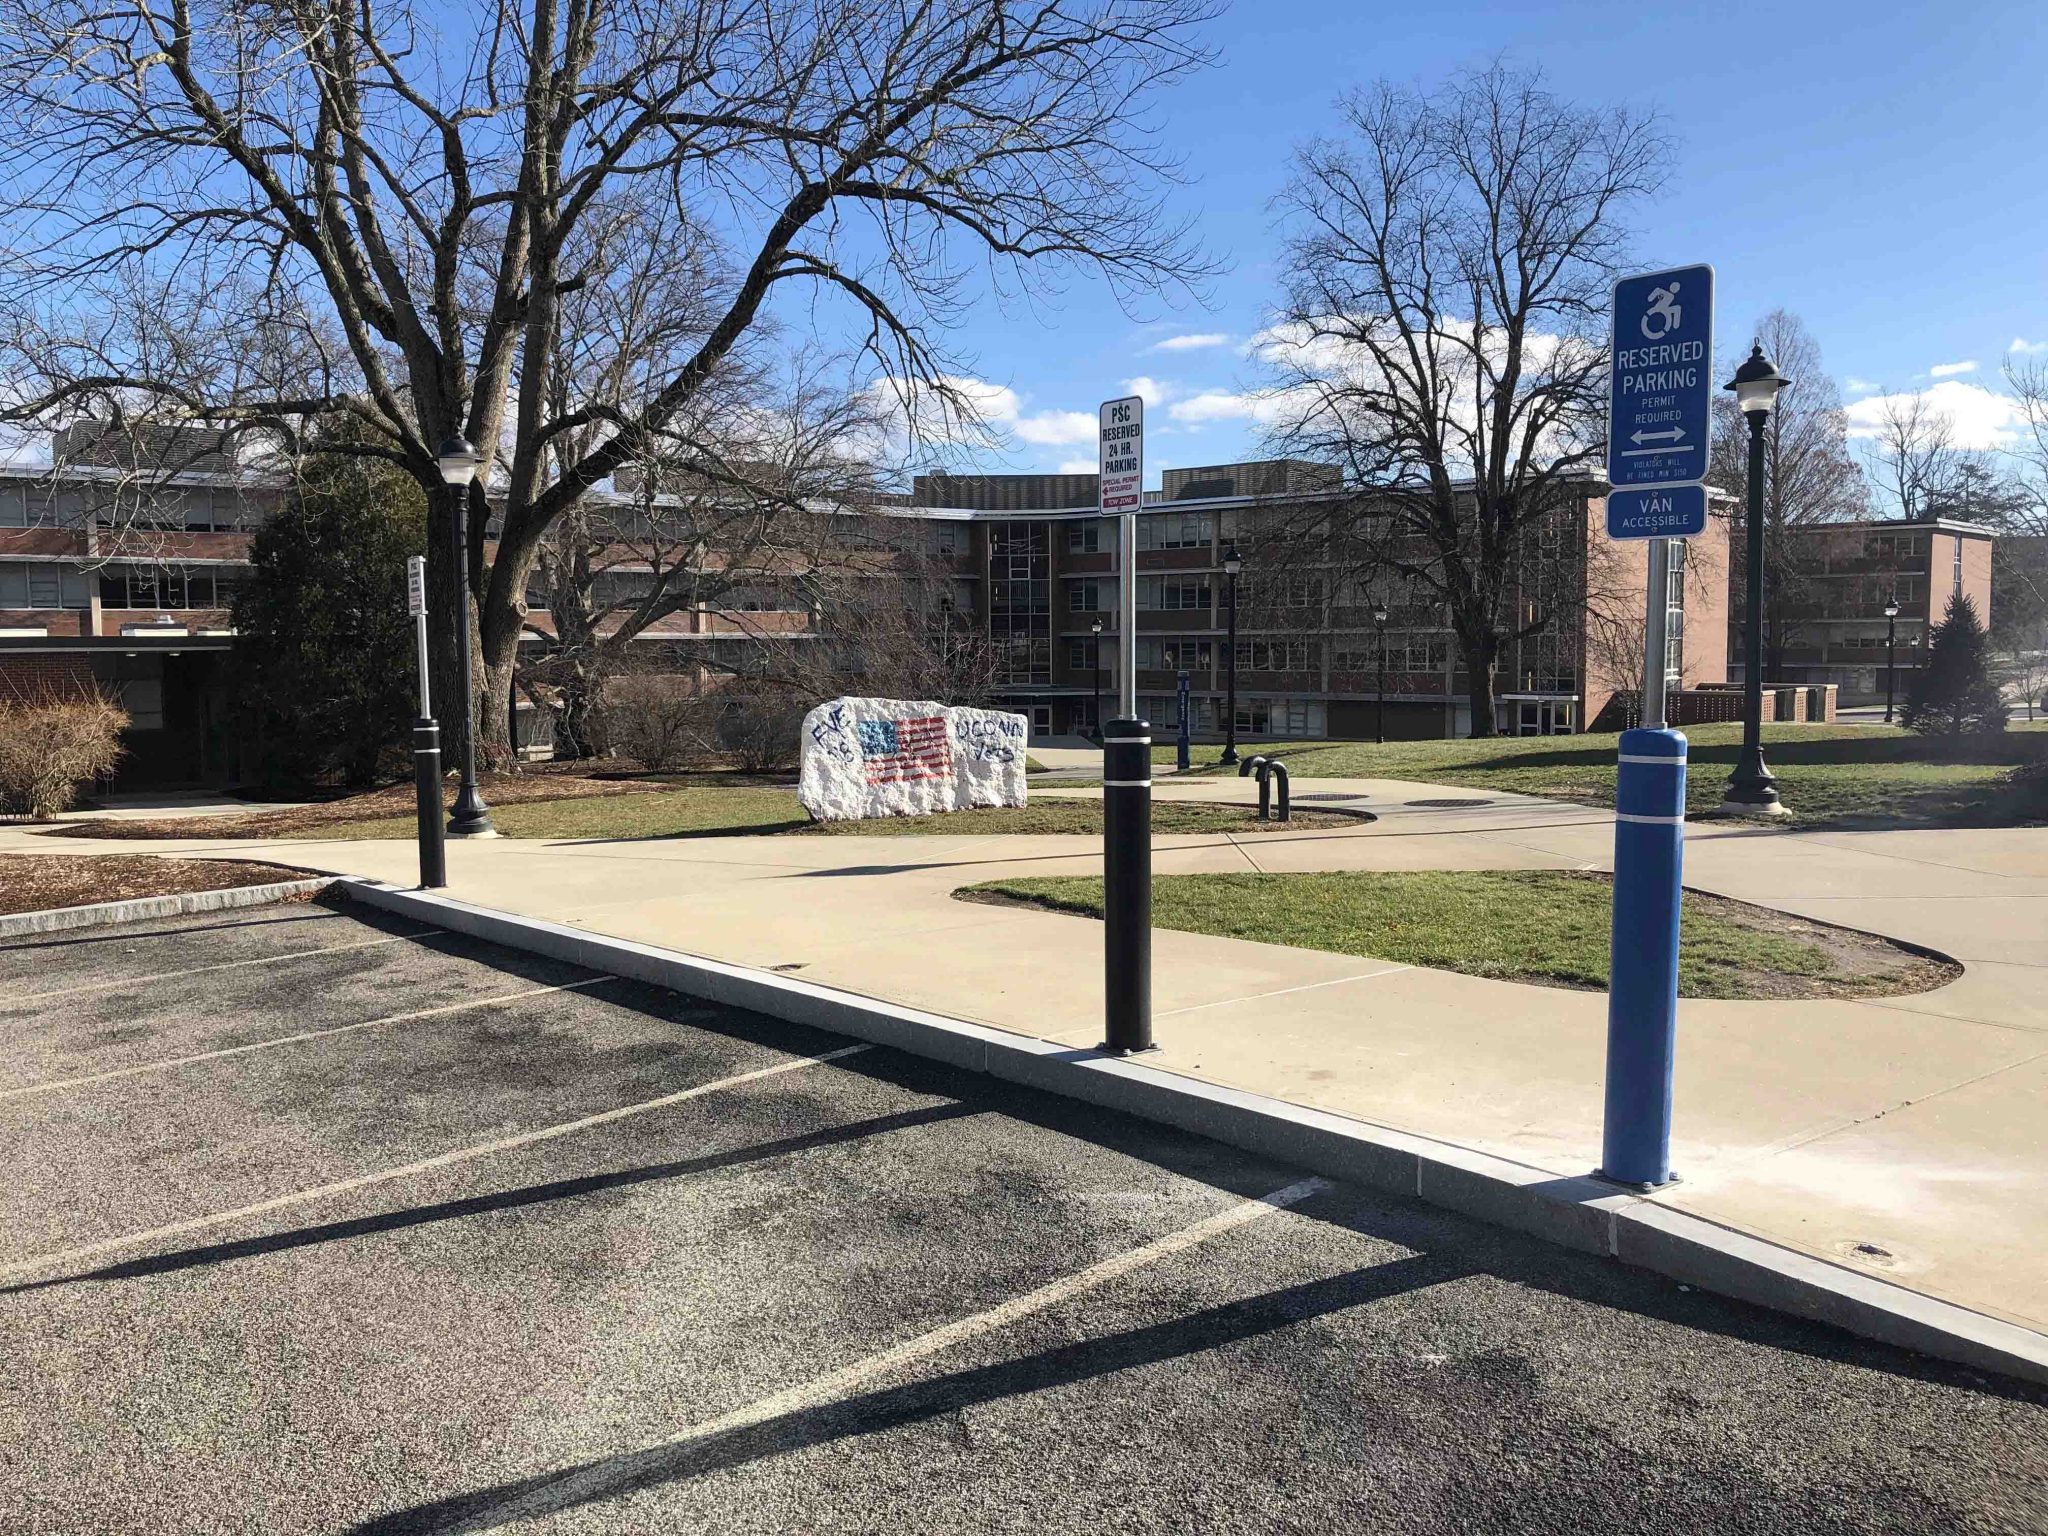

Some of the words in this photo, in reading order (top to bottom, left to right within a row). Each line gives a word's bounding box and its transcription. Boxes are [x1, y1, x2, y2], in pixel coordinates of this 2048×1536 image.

[1618, 341, 1703, 370] RESERVED
[1623, 367, 1697, 395] PARKING
[1642, 395, 1676, 409] PERMIT
[1112, 405, 1130, 424] PSC
[1635, 410, 1682, 424] REQUIRED
[1103, 424, 1140, 442] RESERVED
[1109, 444, 1118, 458] 24
[1121, 442, 1133, 456] HR.
[1105, 457, 1137, 475] PARKING
[1633, 459, 1662, 469] VIOLATORS
[1667, 458, 1680, 466] WILL
[1103, 477, 1121, 487] SPECIAL
[1122, 475, 1139, 484] PERMIT
[1108, 484, 1132, 493] REQUIRED
[1640, 497, 1673, 513] VAN
[1622, 514, 1690, 528] ACCESSIBLE
[955, 720, 1024, 740] UCONN
